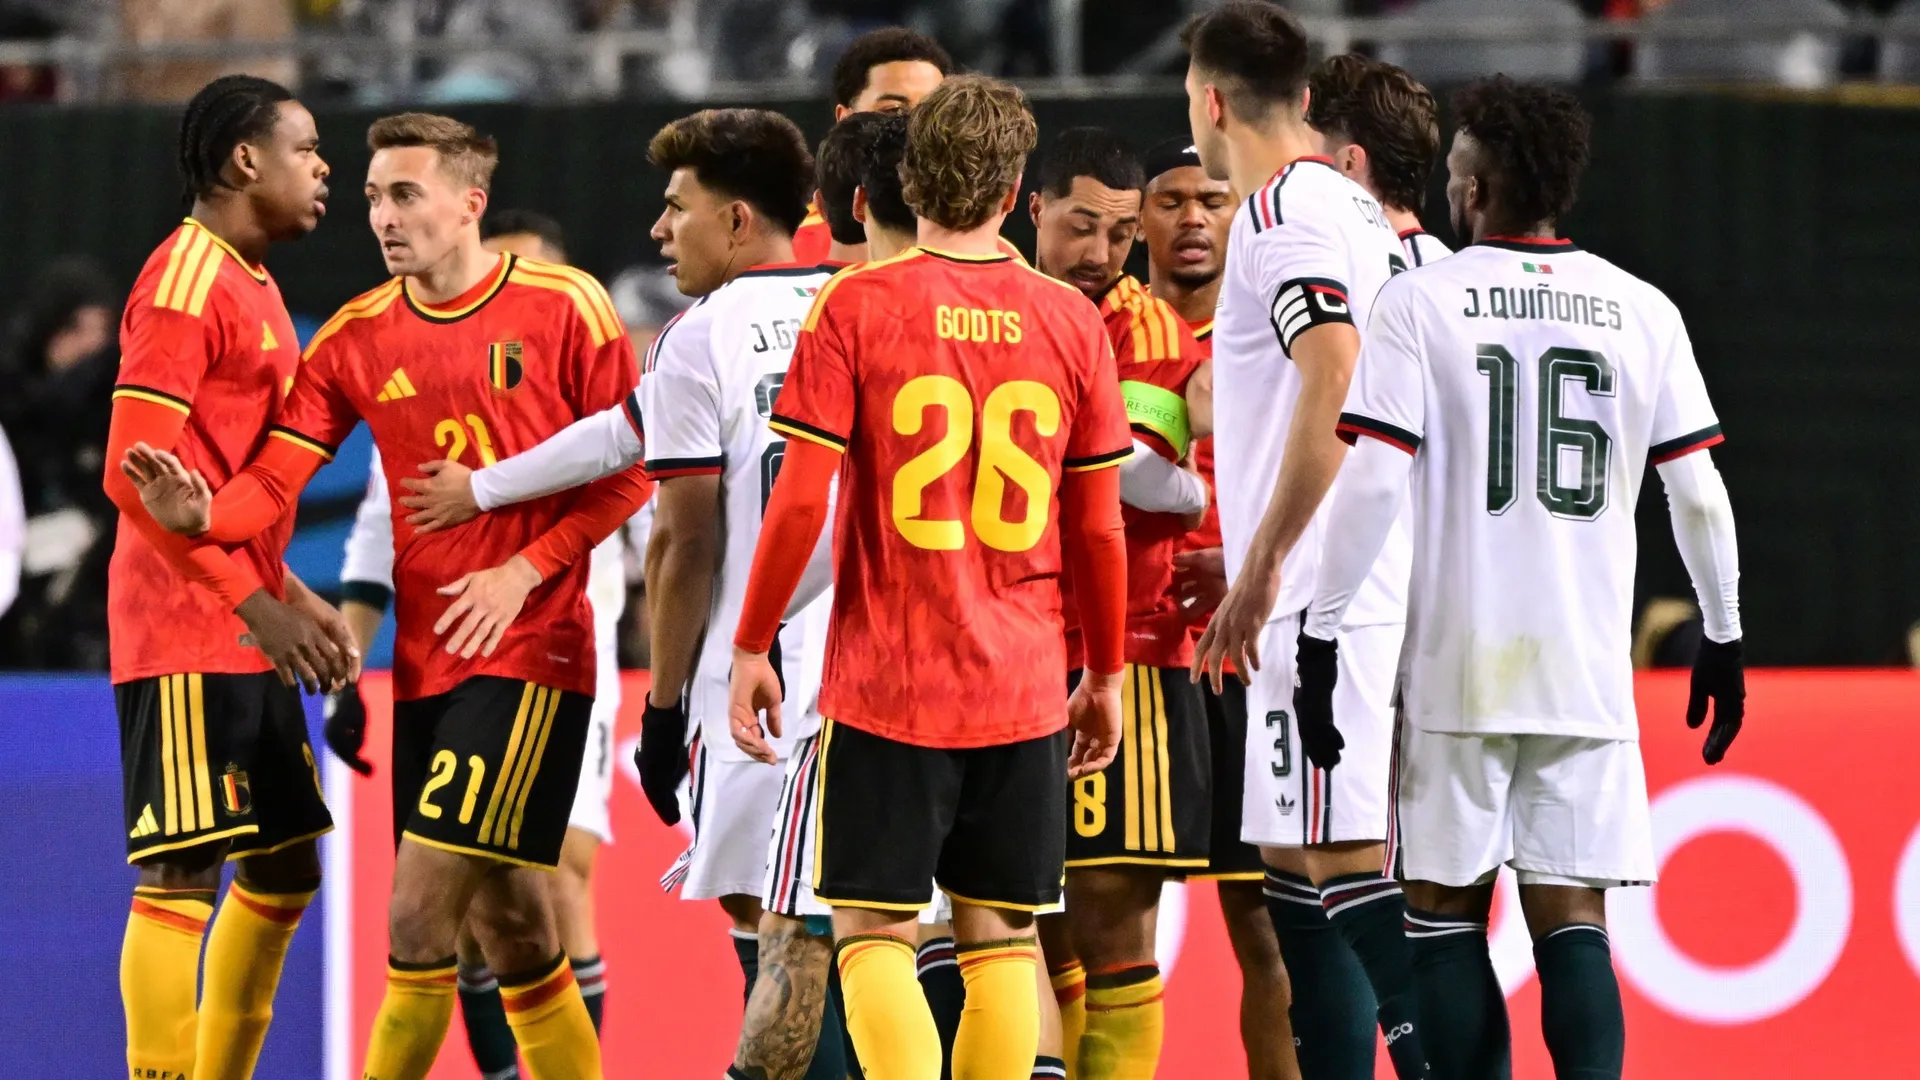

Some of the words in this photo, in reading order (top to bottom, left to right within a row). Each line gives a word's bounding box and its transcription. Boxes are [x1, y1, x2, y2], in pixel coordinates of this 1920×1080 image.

[937, 304, 1022, 344] GODTS
[1463, 283, 1622, 331] J.QUIÑONES
[434, 413, 497, 468] 21
[1126, 400, 1178, 425] RESPECT
[1476, 343, 1617, 522] 16
[892, 375, 1061, 552] 26
[1265, 710, 1292, 779] 3
[419, 749, 486, 824] 21
